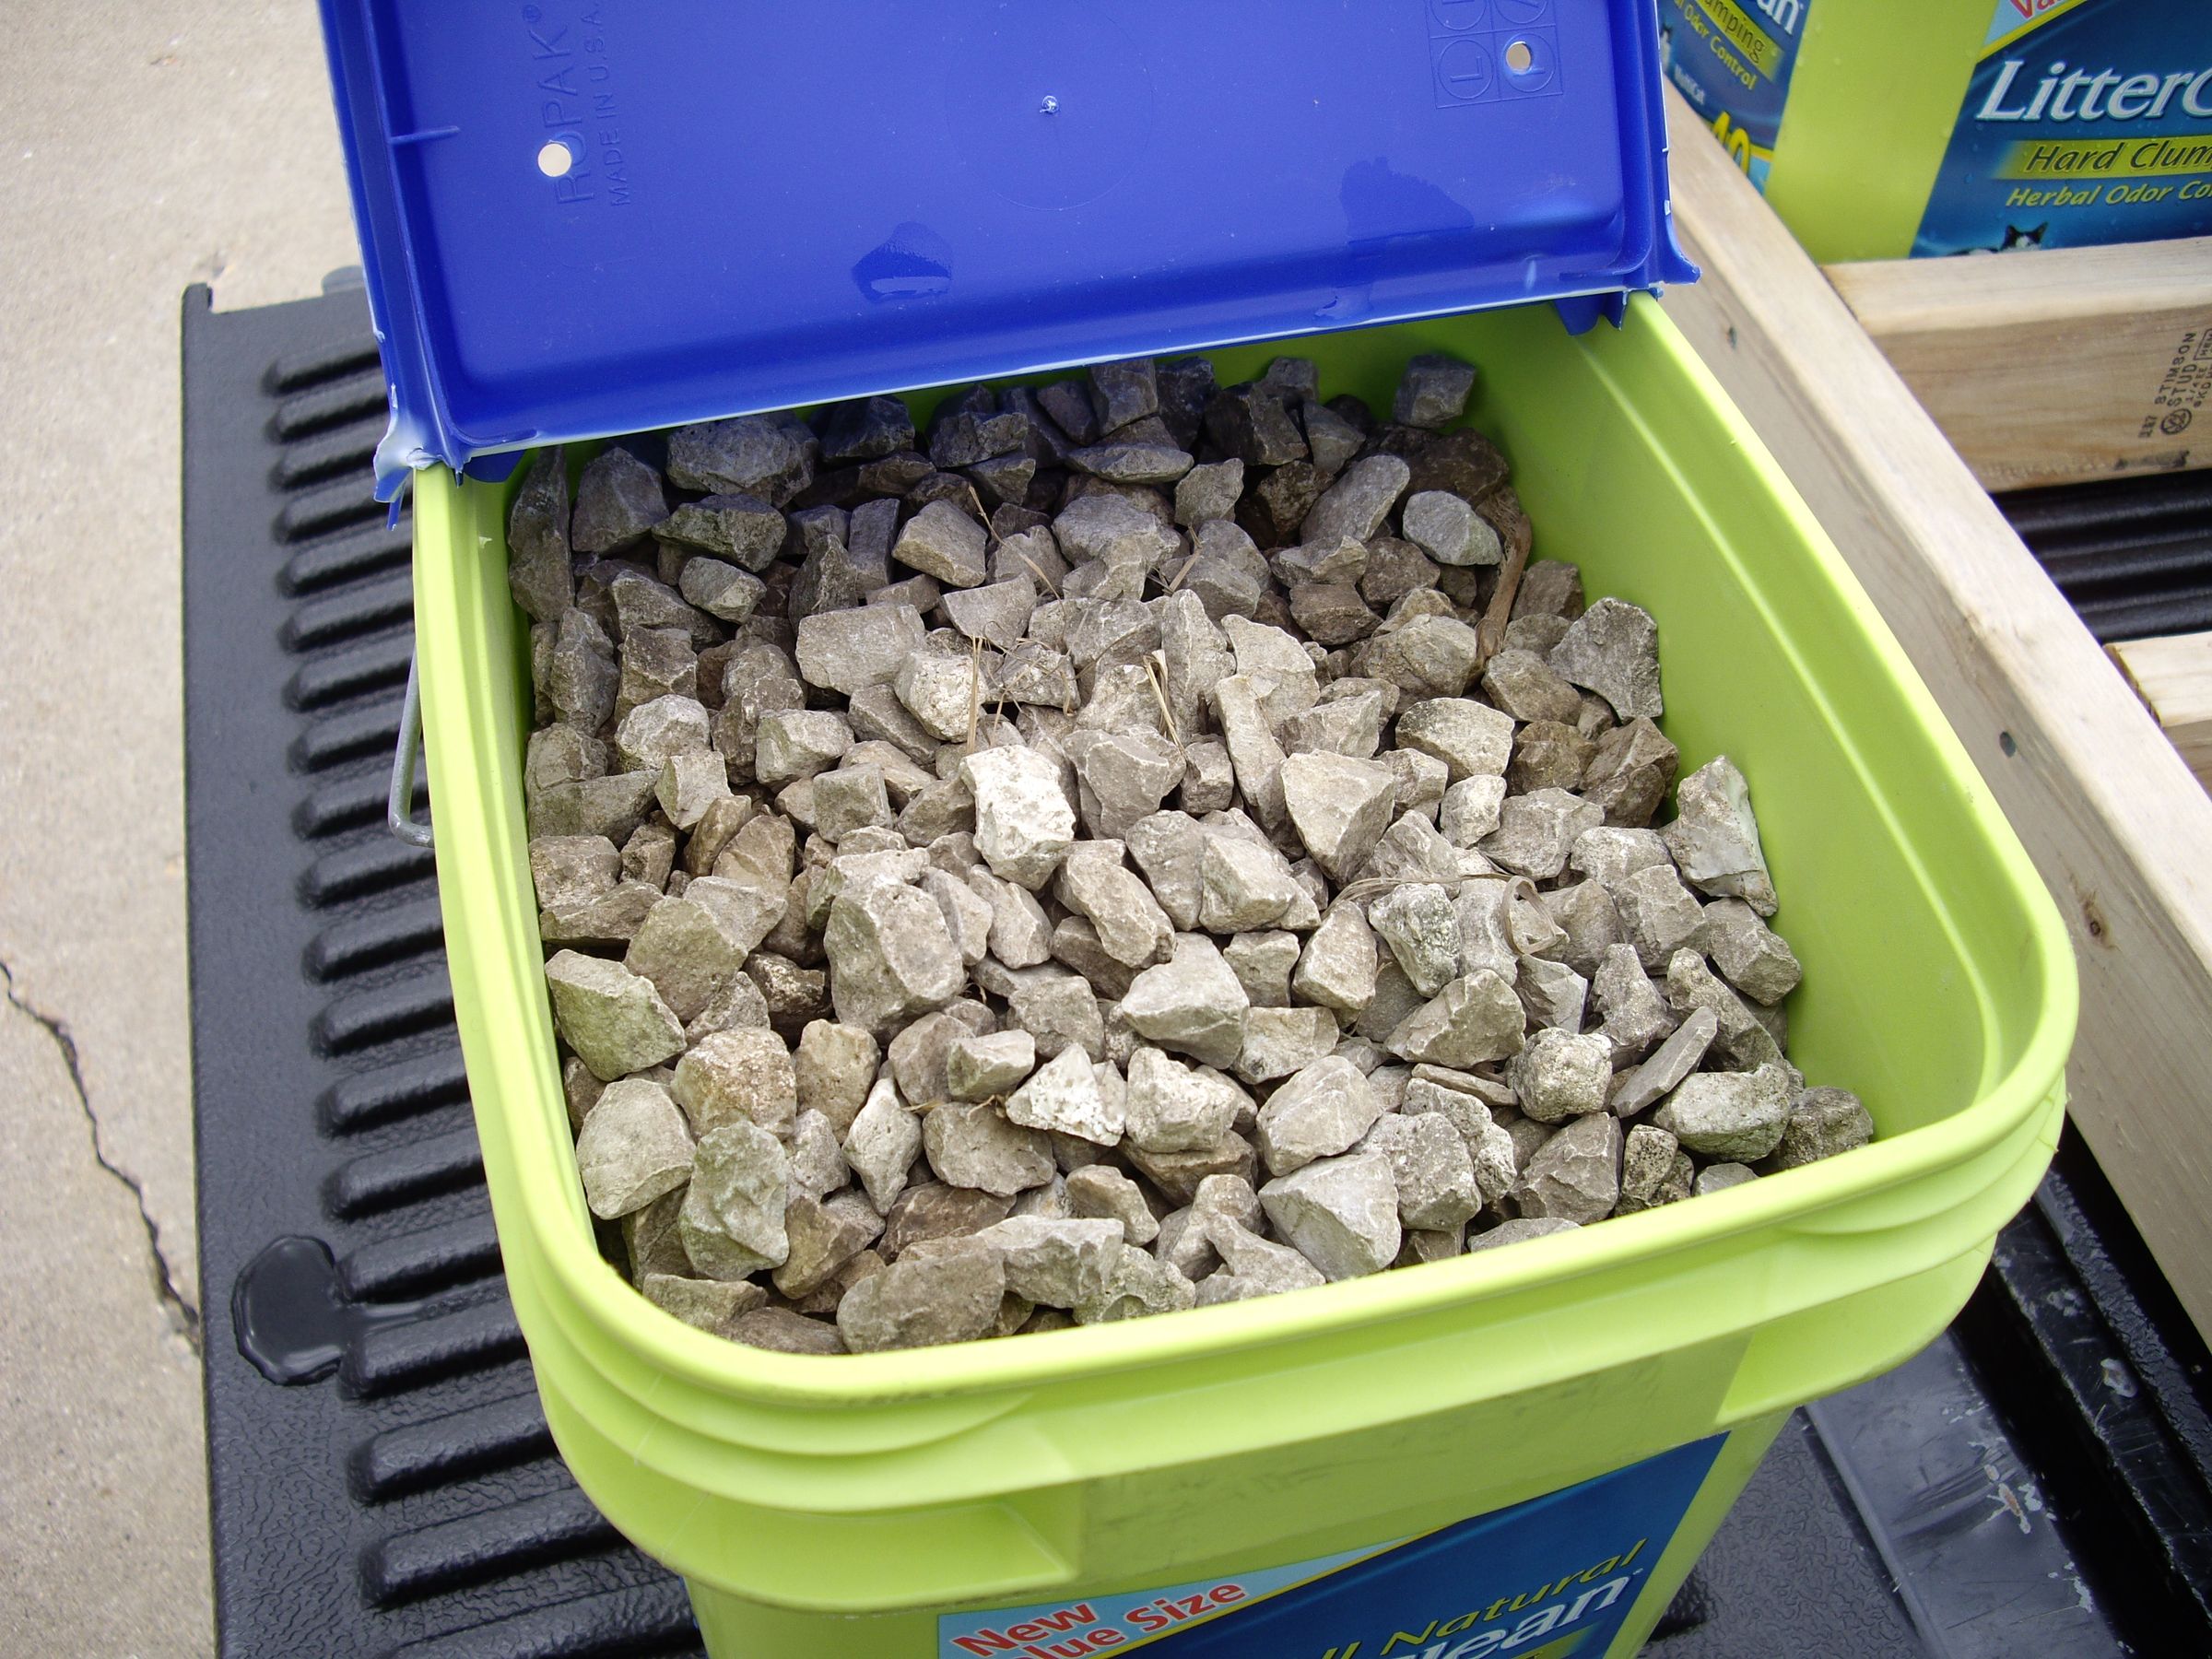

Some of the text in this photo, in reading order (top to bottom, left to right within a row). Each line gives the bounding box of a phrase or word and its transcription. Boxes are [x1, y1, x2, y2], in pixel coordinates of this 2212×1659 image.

[1704, 0, 1766, 64] mping
[1710, 35, 1758, 90] Control
[2025, 142, 2124, 172] Hard
[2006, 185, 2102, 207] Herbal
[2105, 184, 2174, 206] Odor
[2167, 364, 2197, 406] STUD
[1014, 1583, 1247, 1659] lue Size
[1381, 1537, 1648, 1656] Natural
[951, 1603, 1098, 1657] New
